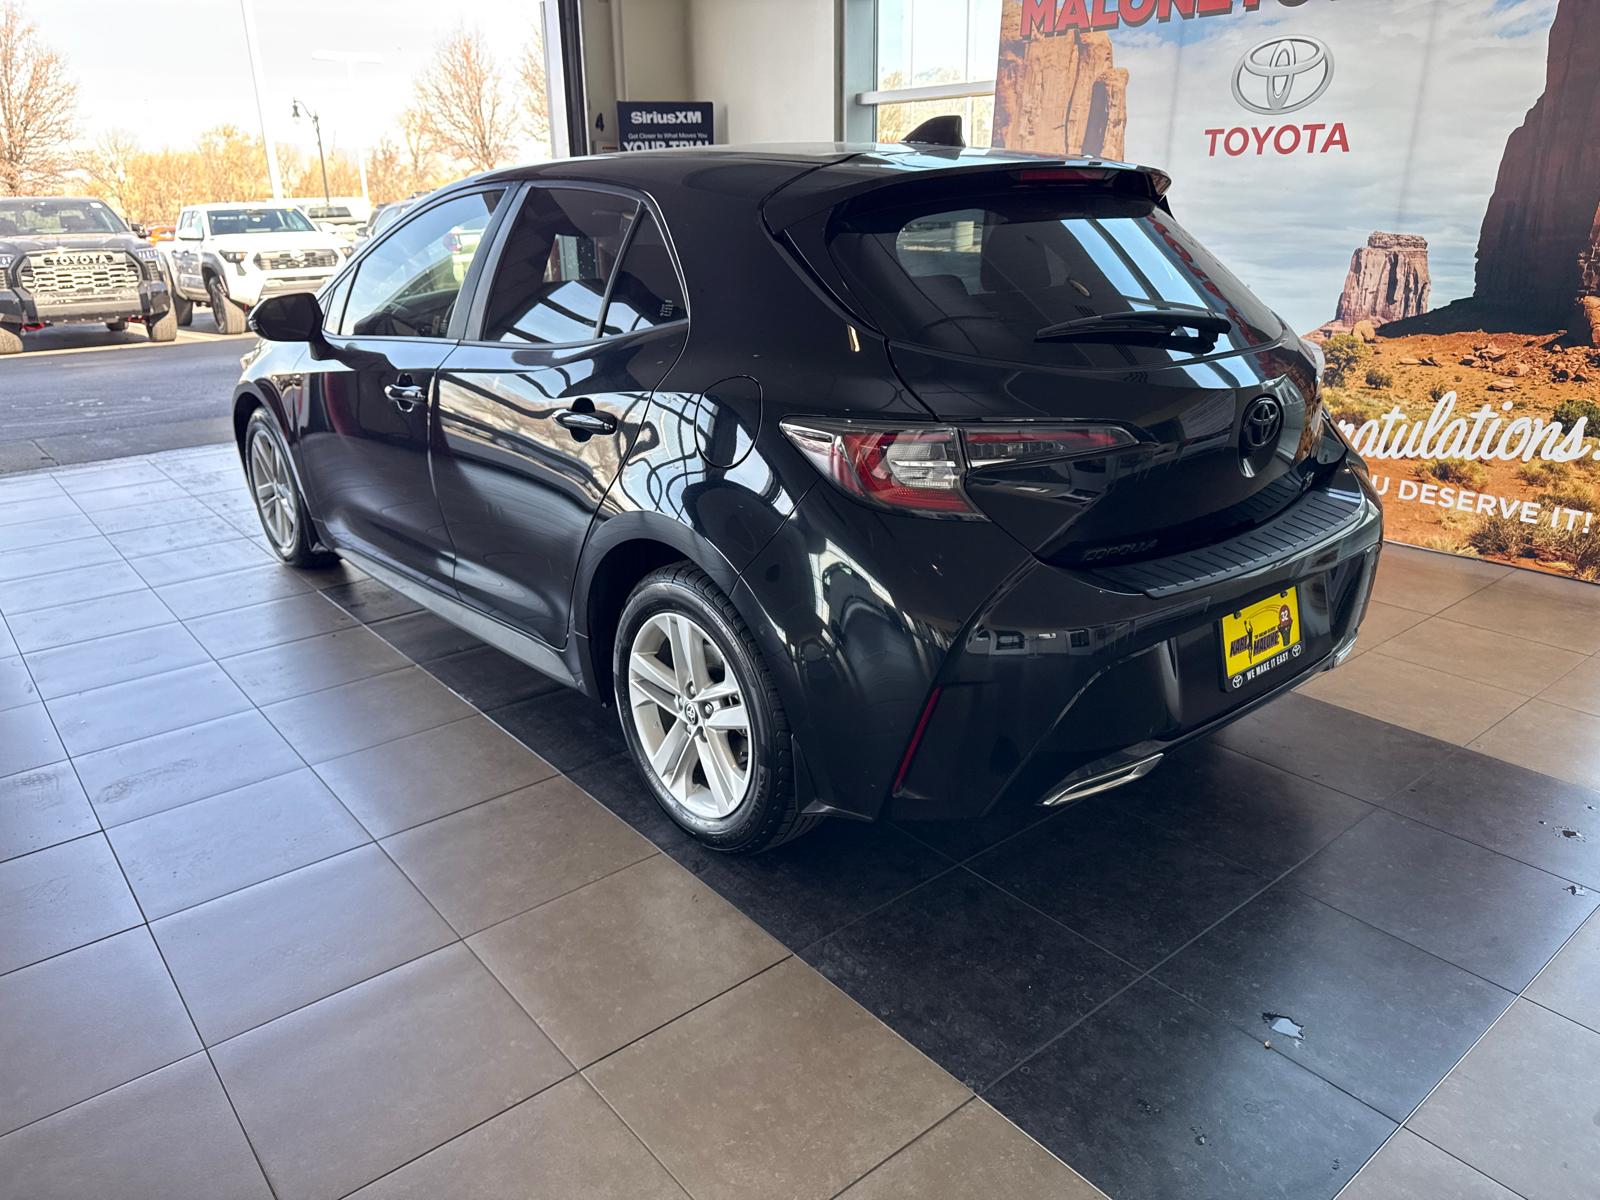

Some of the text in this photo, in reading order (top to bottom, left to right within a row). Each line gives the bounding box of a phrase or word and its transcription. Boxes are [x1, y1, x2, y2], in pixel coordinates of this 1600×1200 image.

[595, 113, 605, 132] 4
[630, 111, 702, 124] SiriusXM
[1205, 123, 1350, 156] TOYOTA
[50, 254, 108, 266] TOYOTA
[1398, 479, 1541, 524] DESERVE
[1551, 506, 1593, 534] IT!
[1281, 609, 1289, 622] 32
[1229, 634, 1249, 658] KARL
[1253, 630, 1280, 656] MALONE
[1246, 651, 1289, 681] WE MAKE IT EASY
